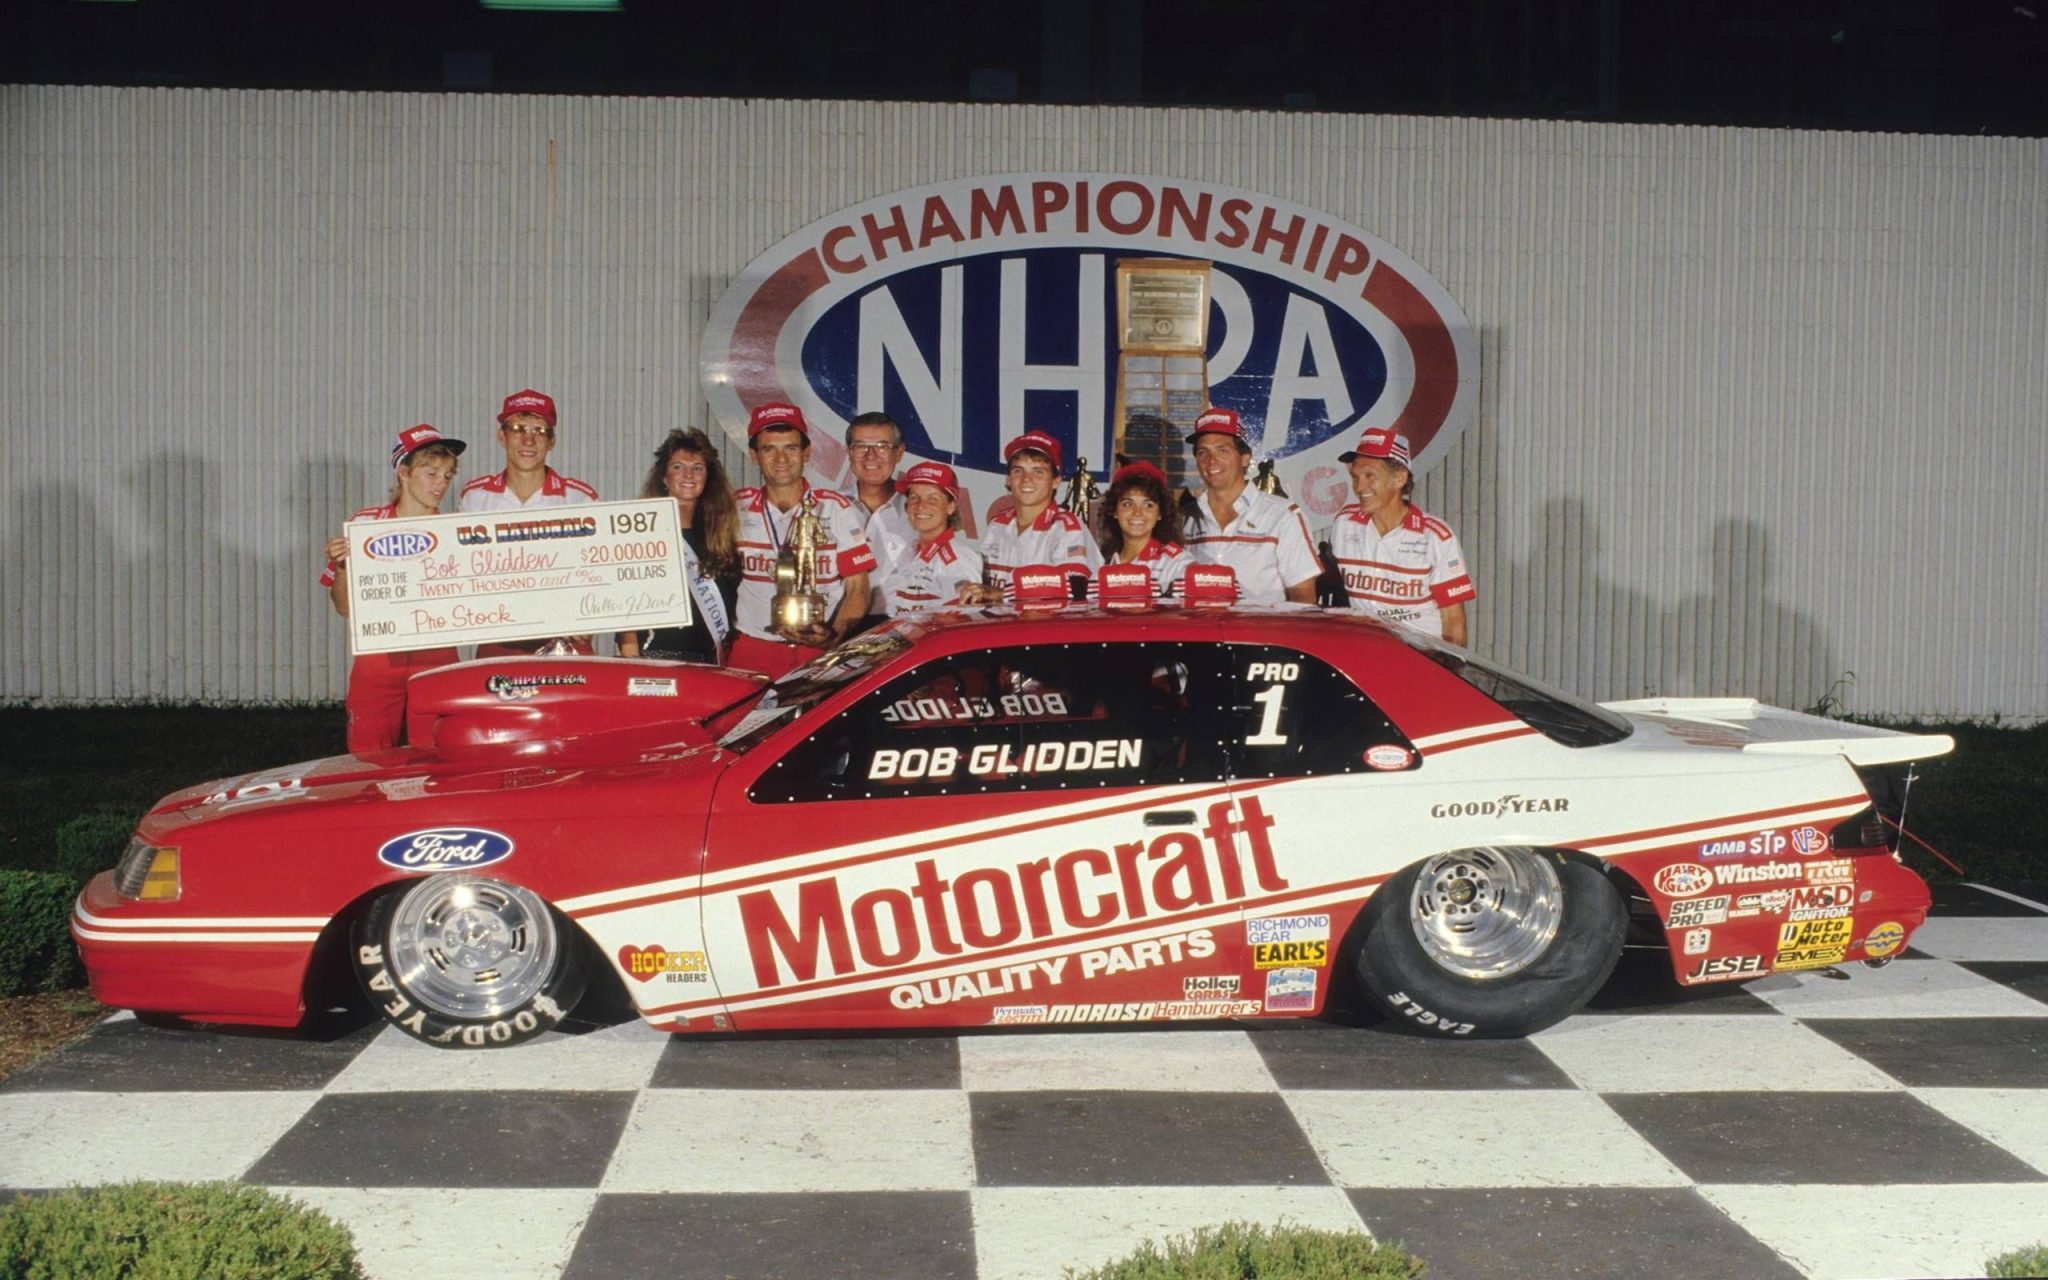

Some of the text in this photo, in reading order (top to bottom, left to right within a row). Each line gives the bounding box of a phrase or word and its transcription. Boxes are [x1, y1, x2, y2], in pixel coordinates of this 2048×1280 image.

[822, 180, 1372, 282] CHAMPIONSHIP
[457, 525, 492, 545] U.S.
[495, 516, 596, 543] NATIONALS
[610, 512, 657, 535] 1987
[374, 534, 428, 556] NHRA
[420, 546, 558, 580] Bob Glidden
[617, 565, 666, 581] DOLLARS
[359, 571, 408, 586] PAY TO THE
[416, 582, 464, 597] TWENTY
[469, 577, 536, 592] THOUSAND
[361, 586, 408, 600] ORDER OF
[362, 621, 396, 636] MEMO
[410, 603, 516, 634] Pro Stock
[1247, 663, 1299, 681] PRO
[1245, 684, 1288, 745] 1
[868, 738, 1142, 779] BOB GLIDDEN
[403, 832, 487, 864] Ford
[1702, 841, 1746, 856] LAMB
[1750, 830, 1786, 854] STP
[1792, 827, 1816, 853] VP
[1715, 861, 1802, 884] Winston
[1804, 859, 1853, 880] TRW
[737, 795, 1291, 989] Motorcraft
[1792, 886, 1853, 910] MSD
[1672, 898, 1725, 914] SPEED
[1789, 907, 1849, 921] IGNITION
[1248, 916, 1328, 931] RICHMOND
[1668, 913, 1704, 927] PRO
[1802, 921, 1844, 933] Auto
[1249, 931, 1290, 943] GEAR
[1798, 932, 1849, 945] Meter
[630, 951, 706, 973] HOOKER
[1256, 941, 1325, 962] EARL'S
[890, 929, 1216, 1010] QUALITY PARTS
[1686, 955, 1767, 979] JESEL
[666, 973, 707, 983] HEADERS
[1185, 977, 1238, 993] Holley
[1048, 1004, 1156, 1023] MOROSO
[1154, 1000, 1262, 1018] Hamburger's
[1388, 991, 1477, 1035] EAGLE
